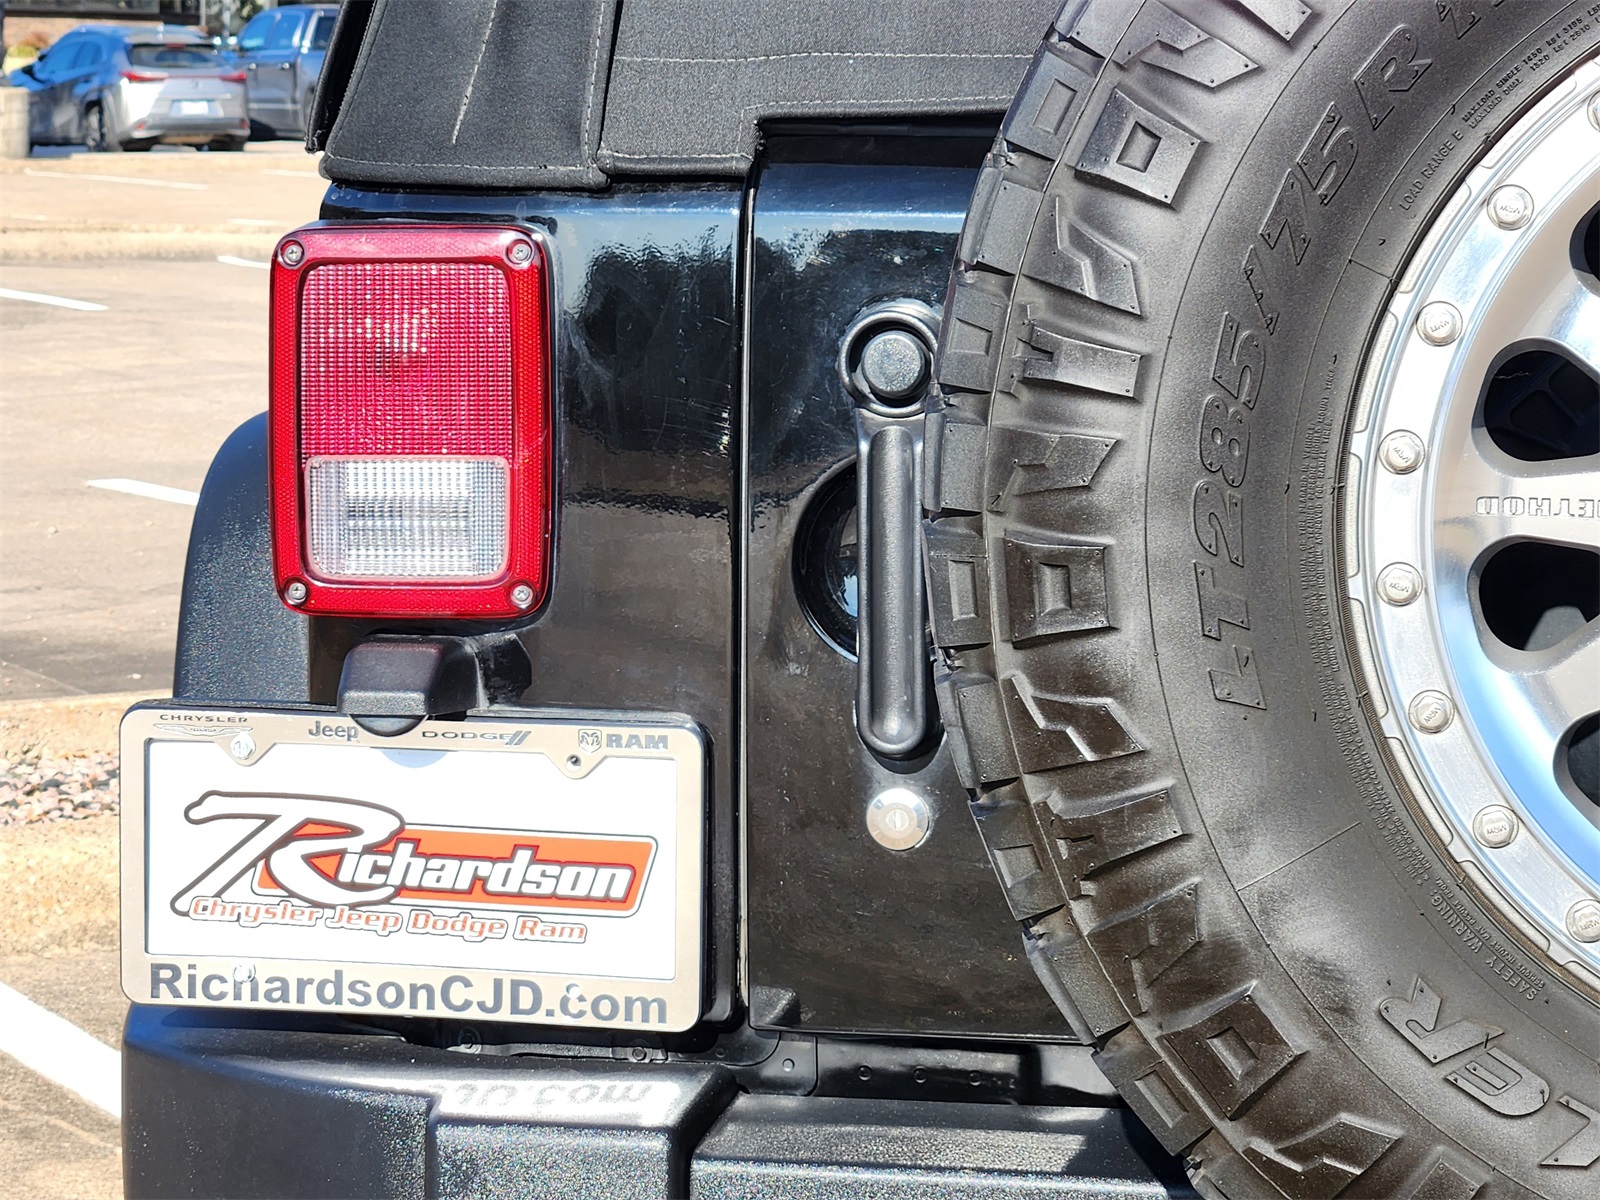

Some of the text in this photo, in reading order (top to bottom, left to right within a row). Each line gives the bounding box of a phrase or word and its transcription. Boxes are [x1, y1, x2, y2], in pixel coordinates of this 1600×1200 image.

[1399, 130, 1464, 210] LOAD RANGE E
[1475, 496, 1600, 518] ETHOD
[159, 713, 248, 724] CHRYSLER
[308, 720, 360, 742] Jeep
[421, 730, 512, 743] DODGE
[606, 733, 669, 750] RAM
[170, 790, 638, 916] Richardson
[192, 896, 587, 941] Chrysler Jeep Dodge Ram
[1426, 890, 1538, 1001] SAFETY WARNING:
[149, 962, 668, 1024] RichardsonCJD.com
